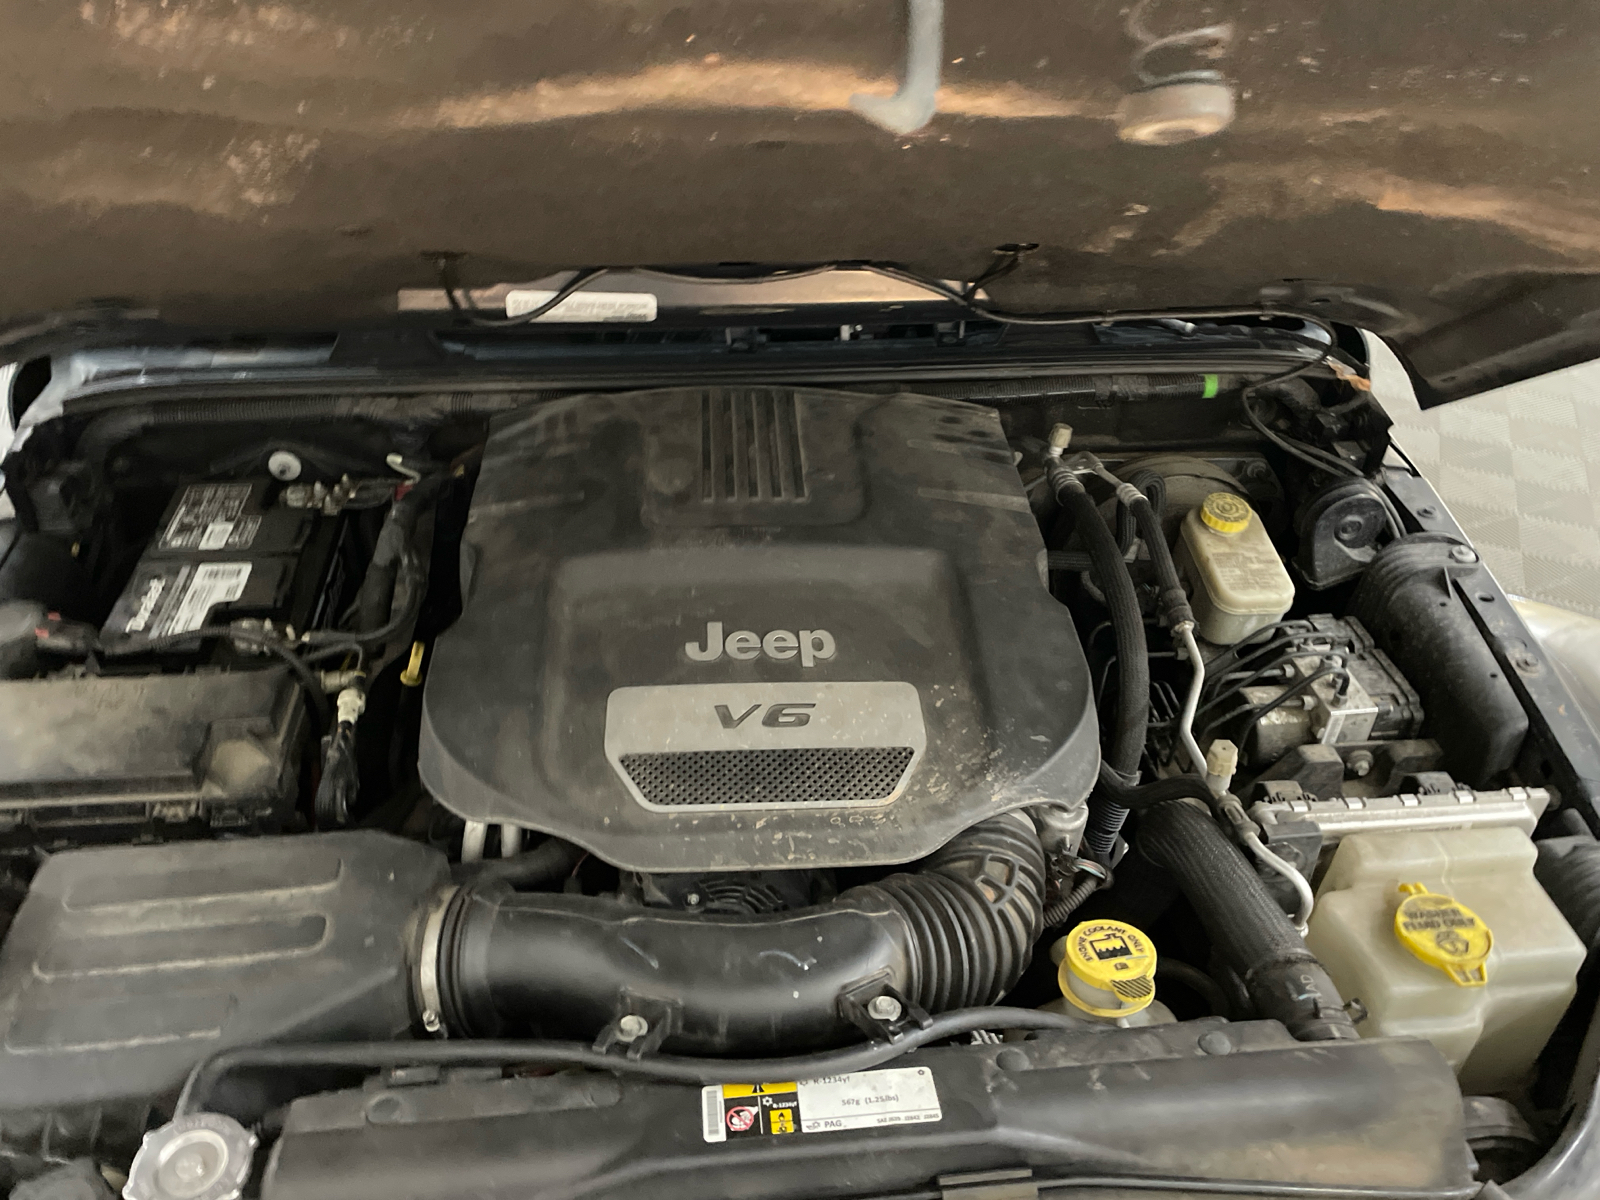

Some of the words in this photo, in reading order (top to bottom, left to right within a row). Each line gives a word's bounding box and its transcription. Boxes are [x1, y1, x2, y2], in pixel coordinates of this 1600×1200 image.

[684, 621, 837, 668] Jeep
[714, 703, 816, 729] V6
[1083, 926, 1126, 936] COOLANT
[1078, 936, 1093, 962] ENGINE
[1127, 934, 1144, 953] ONLY
[824, 1120, 842, 1128] PAG
